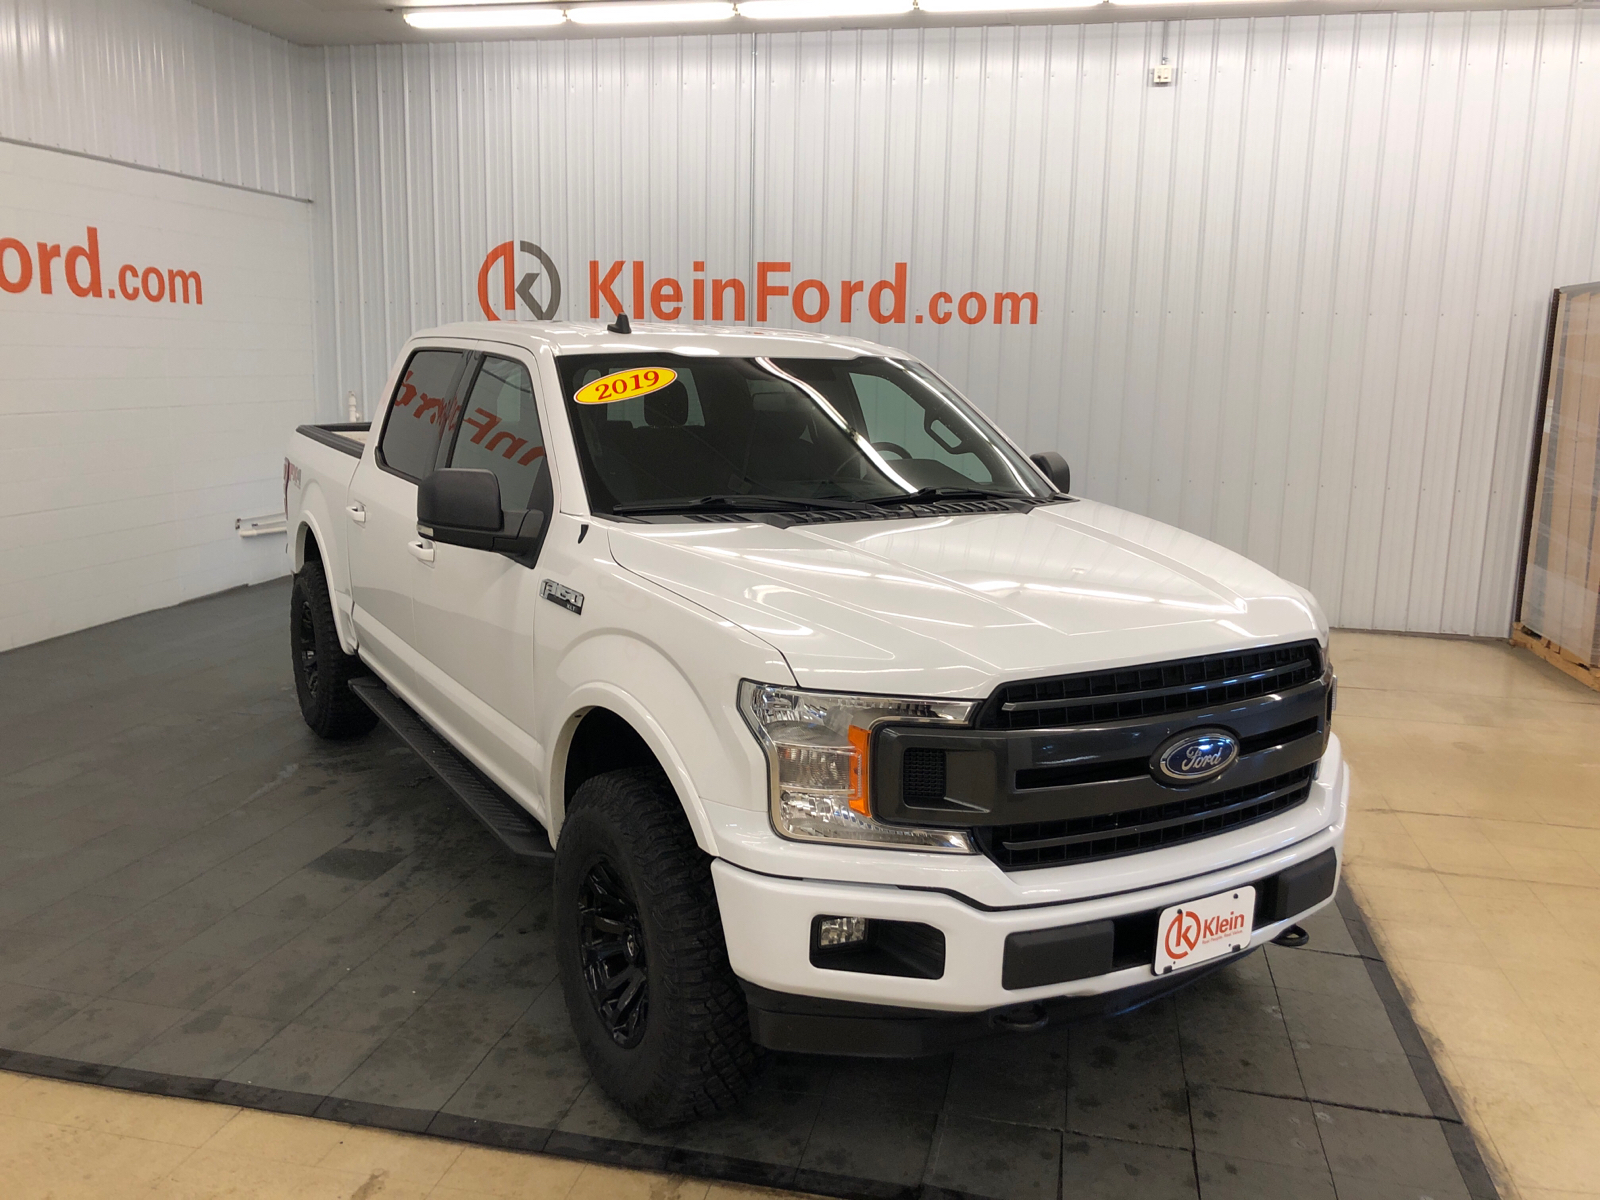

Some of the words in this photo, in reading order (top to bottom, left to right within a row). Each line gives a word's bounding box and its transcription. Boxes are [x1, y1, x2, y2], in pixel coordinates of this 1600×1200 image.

[589, 260, 1038, 325] KleinFord.com
[594, 370, 660, 401] 2019
[1181, 745, 1223, 771] Ford
[1203, 911, 1244, 938] Klein
